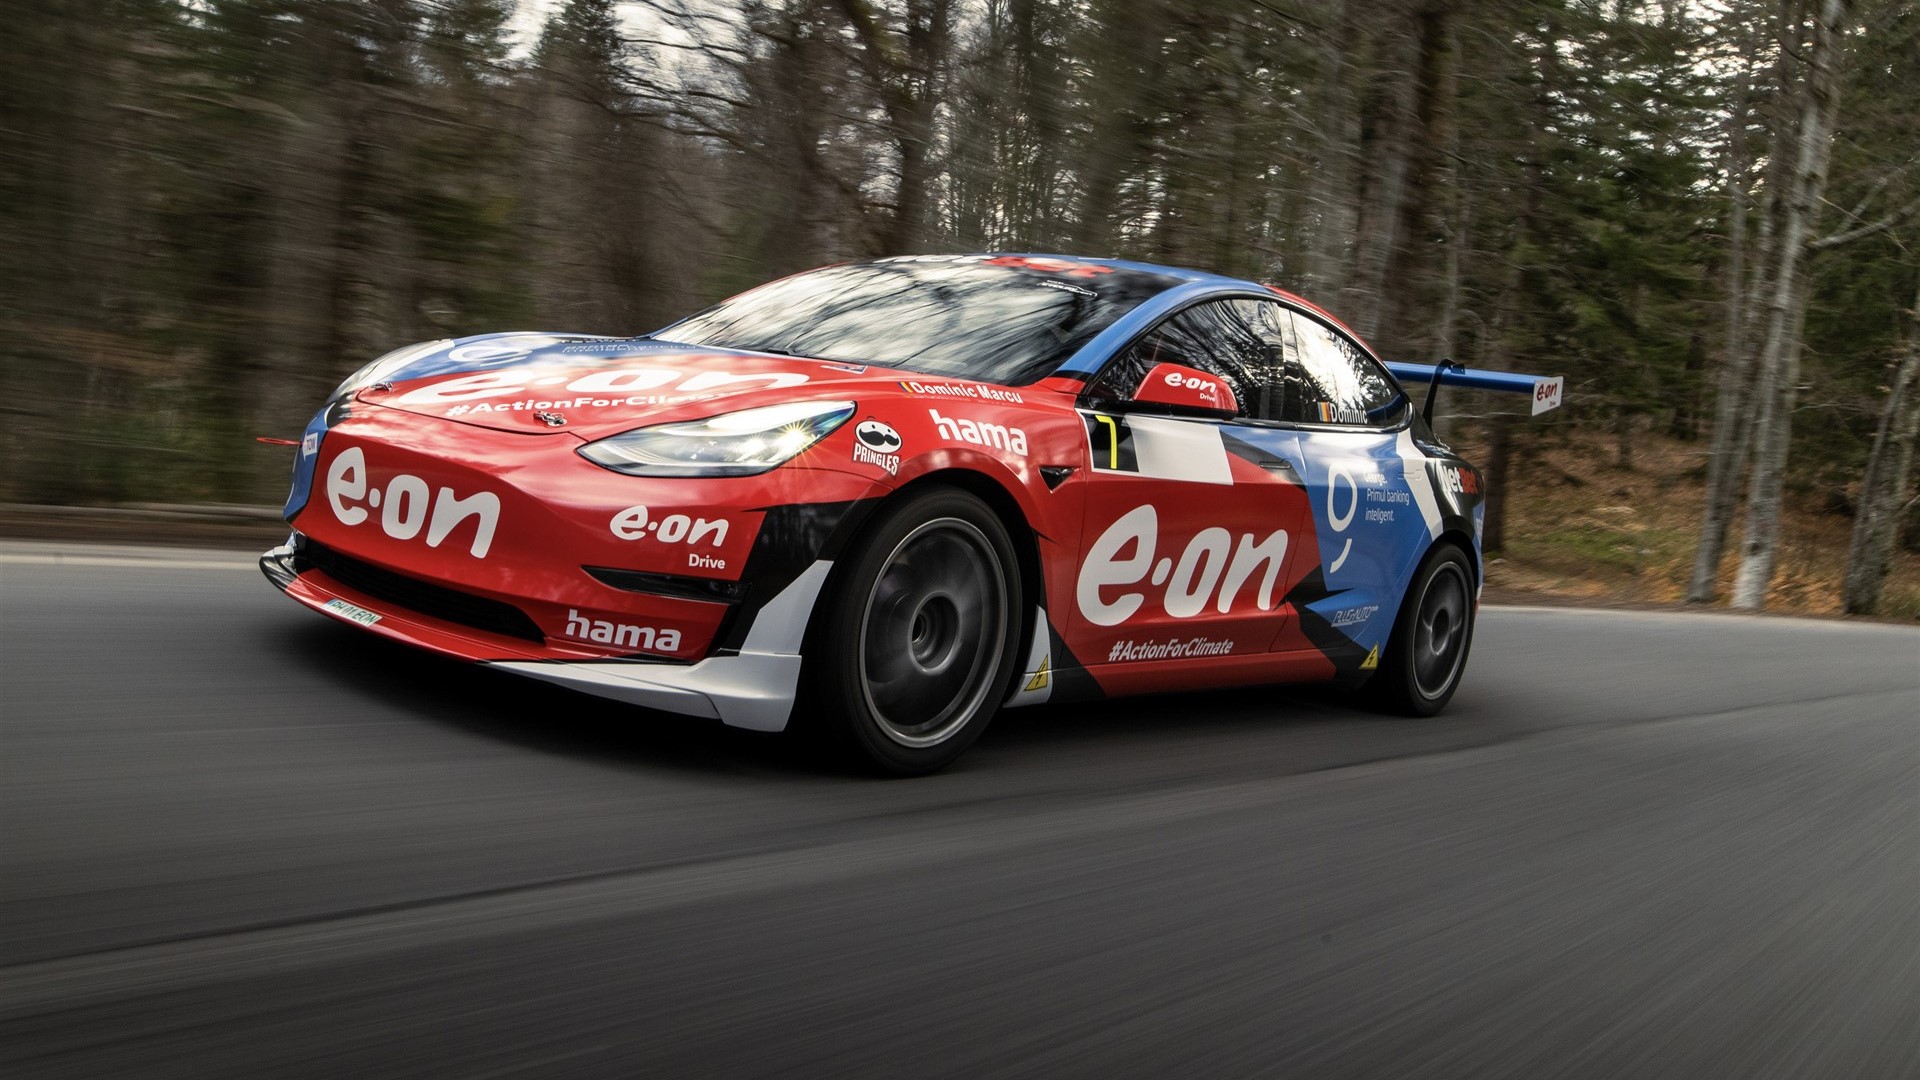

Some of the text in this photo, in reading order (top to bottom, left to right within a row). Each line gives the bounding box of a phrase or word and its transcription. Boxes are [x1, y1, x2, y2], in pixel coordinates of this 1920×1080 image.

[909, 381, 978, 398] Dominic
[976, 384, 1024, 404] Marcu
[1200, 392, 1216, 402] Drive
[1330, 402, 1368, 425] Dominic
[928, 408, 1029, 456] hama
[1095, 415, 1118, 470] 7
[853, 442, 900, 477] PRINGLES
[1366, 488, 1386, 502] Primul
[1387, 489, 1410, 506] banking
[688, 553, 726, 570] Drive
[566, 608, 682, 652] hama
[1108, 637, 1235, 662] #ActionForClimate
